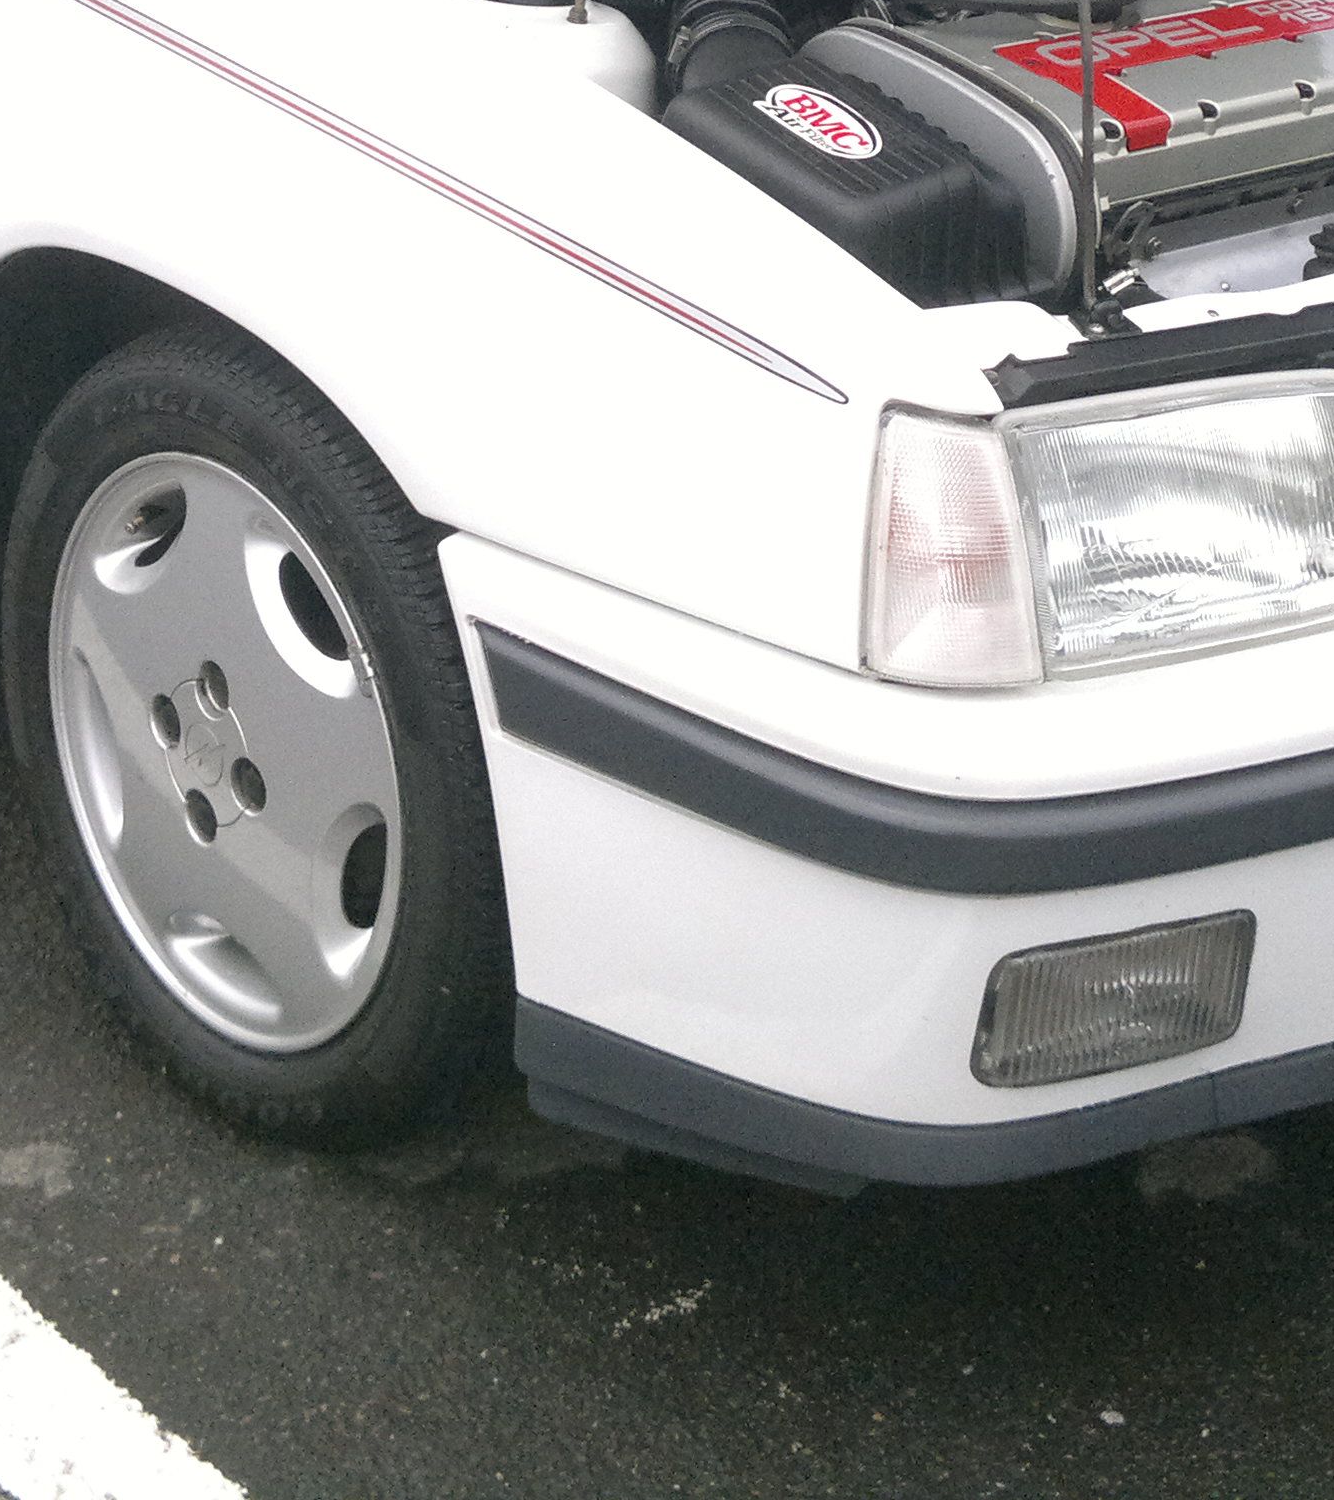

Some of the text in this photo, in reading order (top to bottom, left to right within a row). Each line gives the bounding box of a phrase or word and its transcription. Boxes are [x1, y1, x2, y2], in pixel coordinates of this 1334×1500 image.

[1034, 15, 1264, 67] OPEL
[762, 103, 804, 129] Air
[779, 93, 870, 150] BMC
